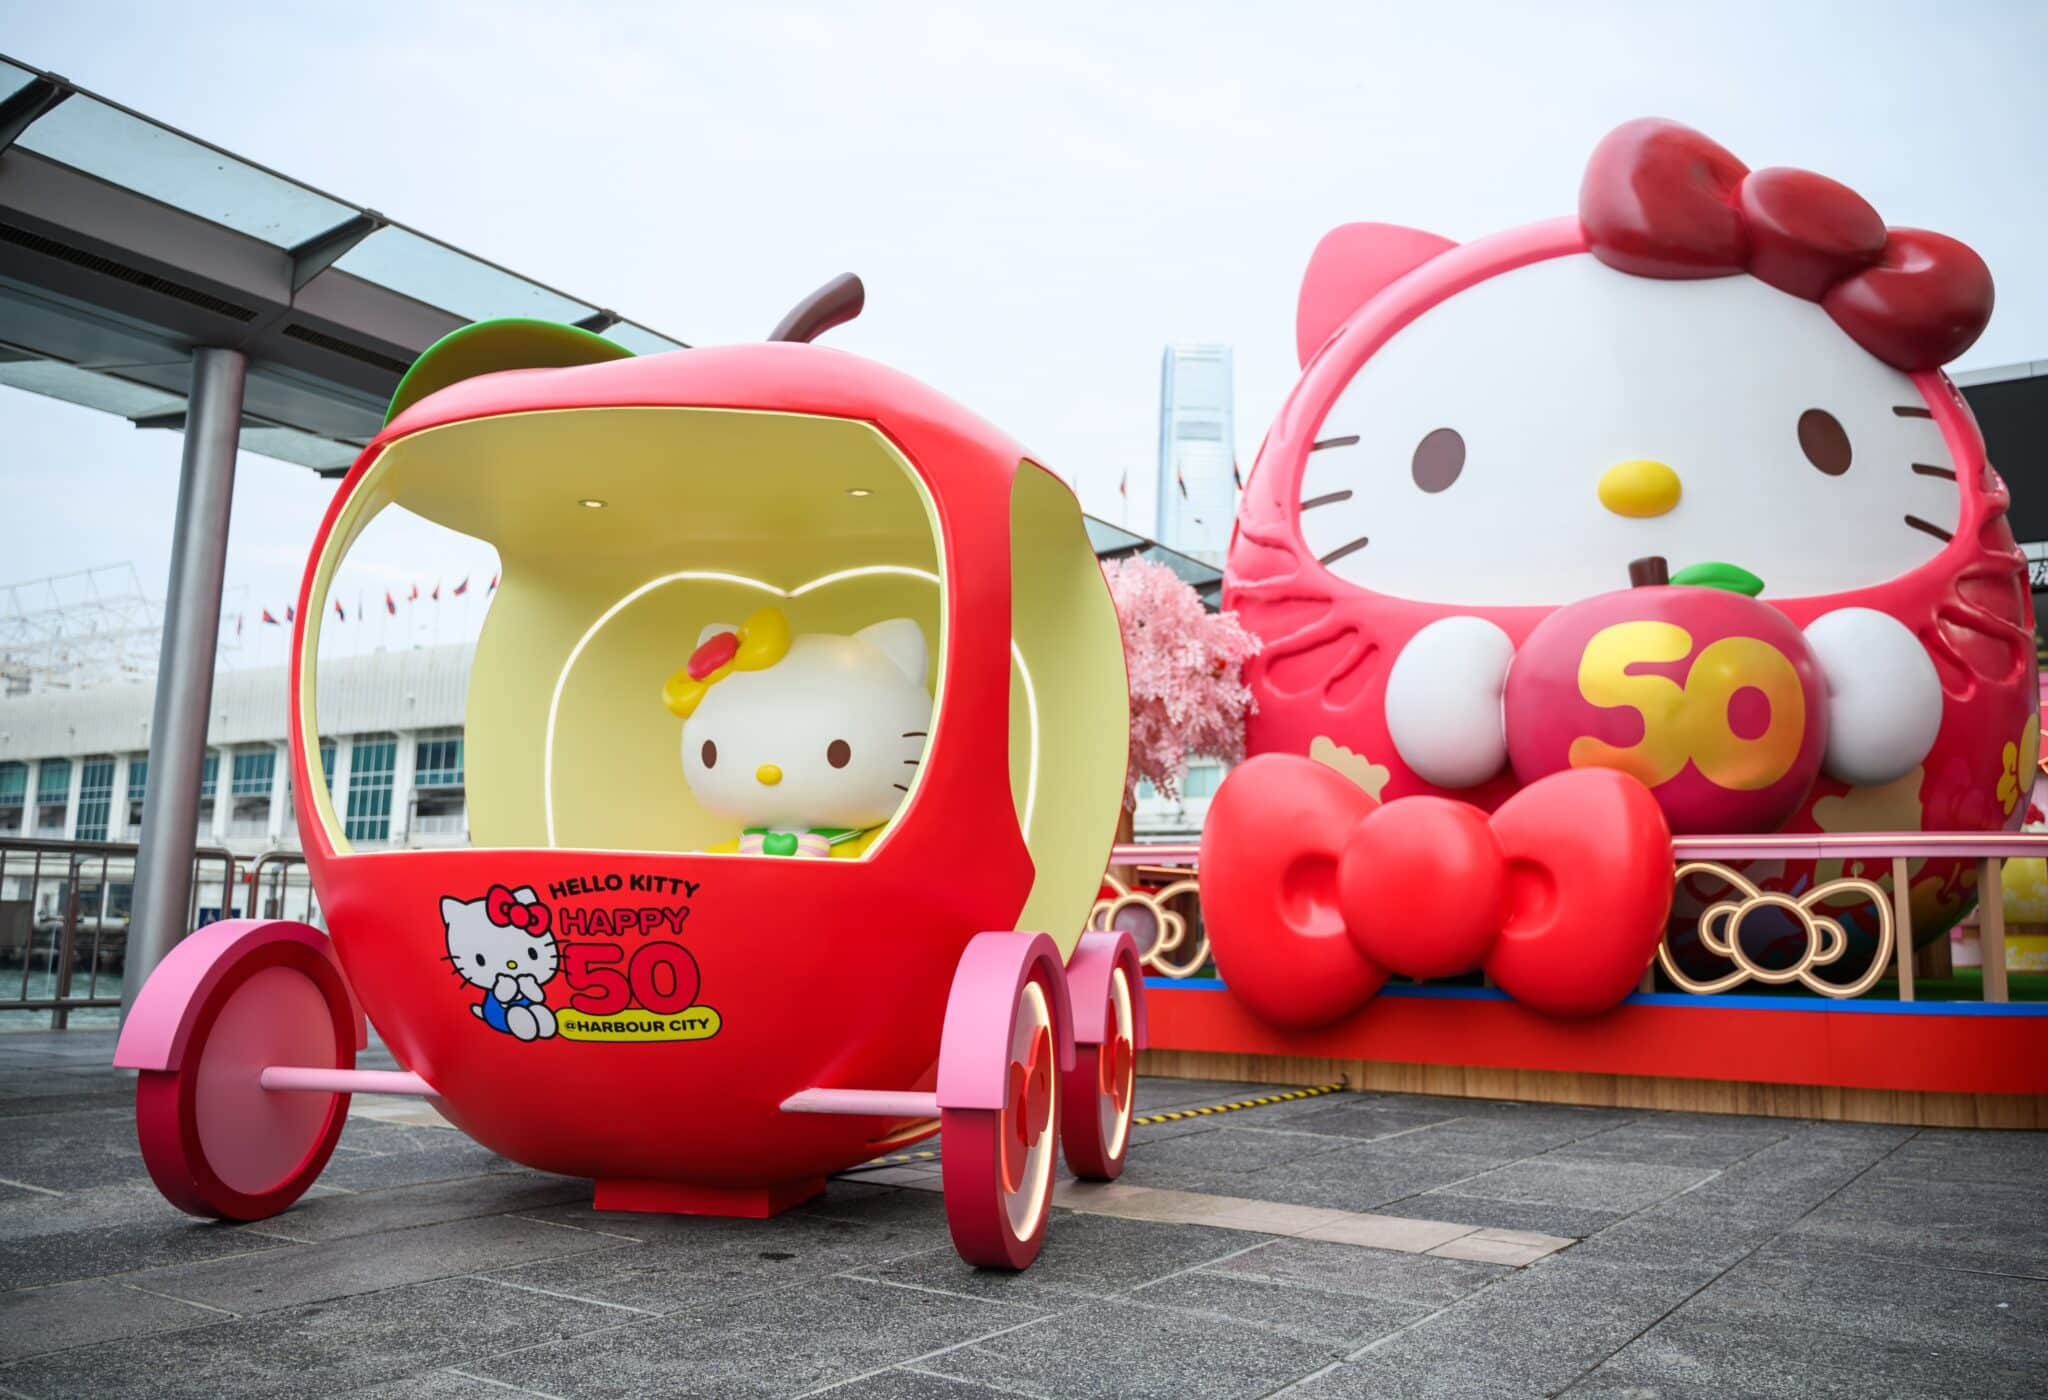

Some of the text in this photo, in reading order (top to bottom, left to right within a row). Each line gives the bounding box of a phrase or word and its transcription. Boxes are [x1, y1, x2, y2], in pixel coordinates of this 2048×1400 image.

[1568, 620, 1806, 791] 50
[549, 874, 700, 899] HELLO KITTY
[560, 906, 690, 935] HAPPY
[564, 940, 700, 1016] 50
[565, 1018, 709, 1032] @HARBOUR CITY
